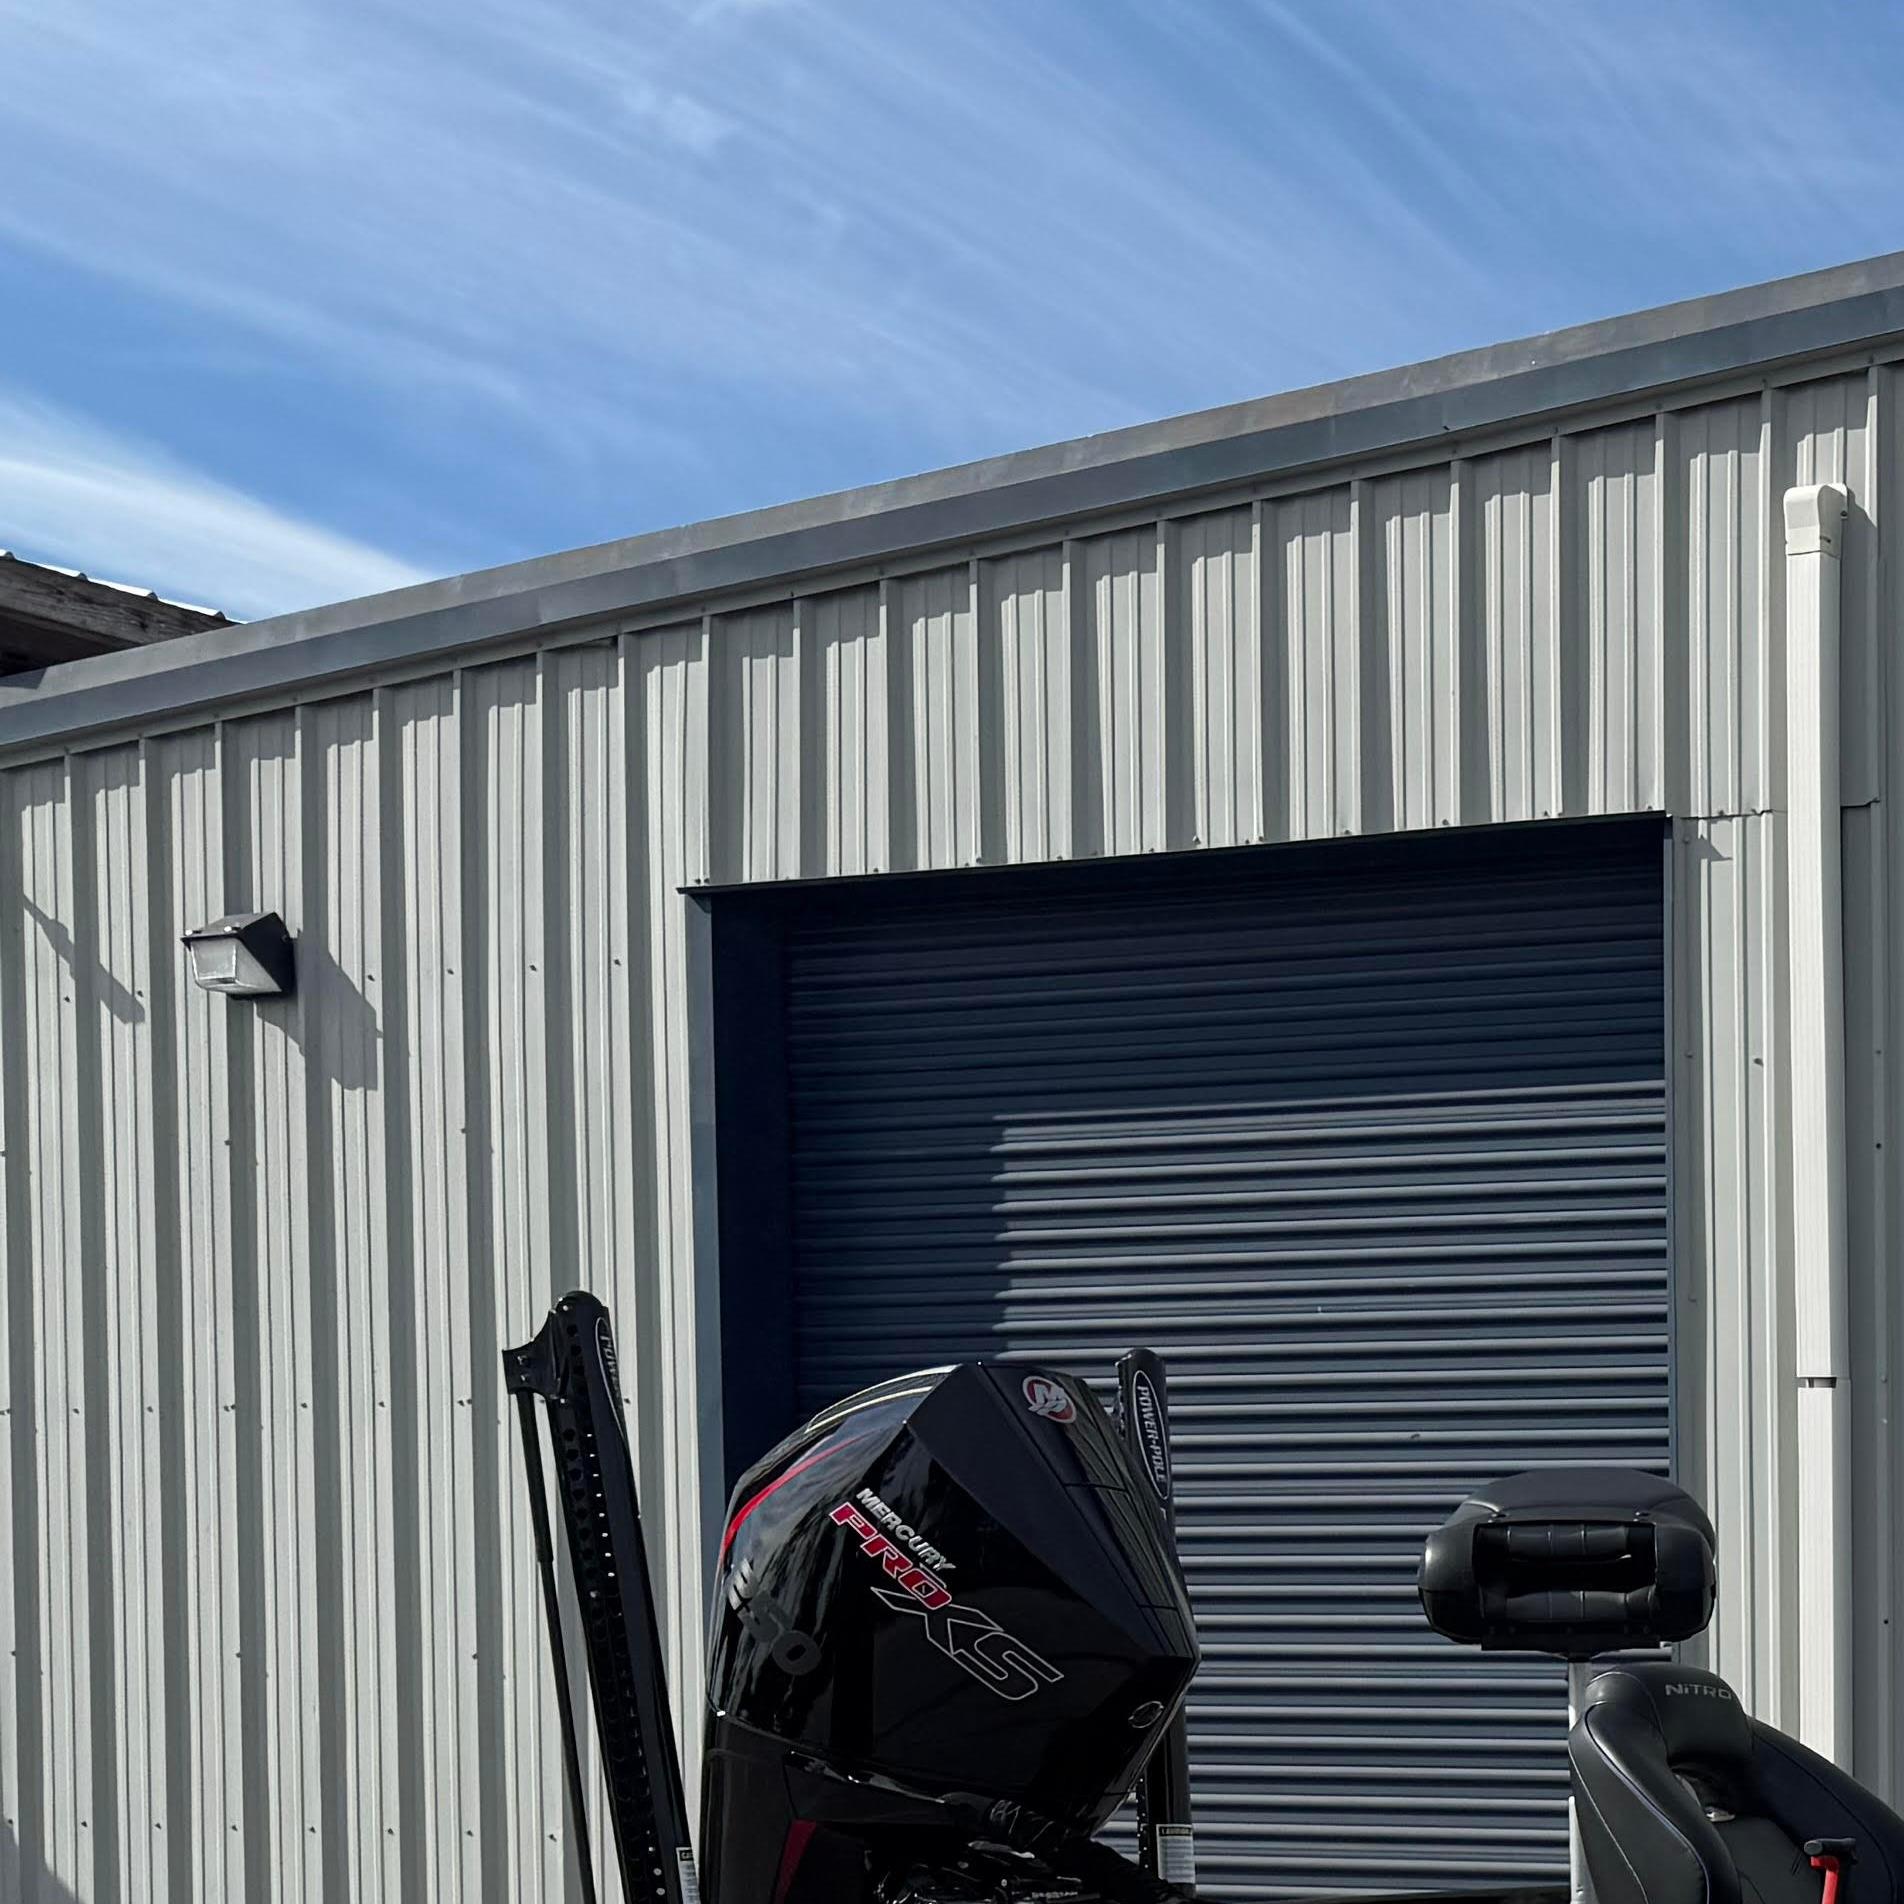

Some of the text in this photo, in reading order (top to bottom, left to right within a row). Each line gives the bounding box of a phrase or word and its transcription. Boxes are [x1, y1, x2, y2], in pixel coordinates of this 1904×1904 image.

[828, 1501, 953, 1611] PRO
[855, 1487, 957, 1571] MERCURY
[869, 1562, 1065, 1701] XS
